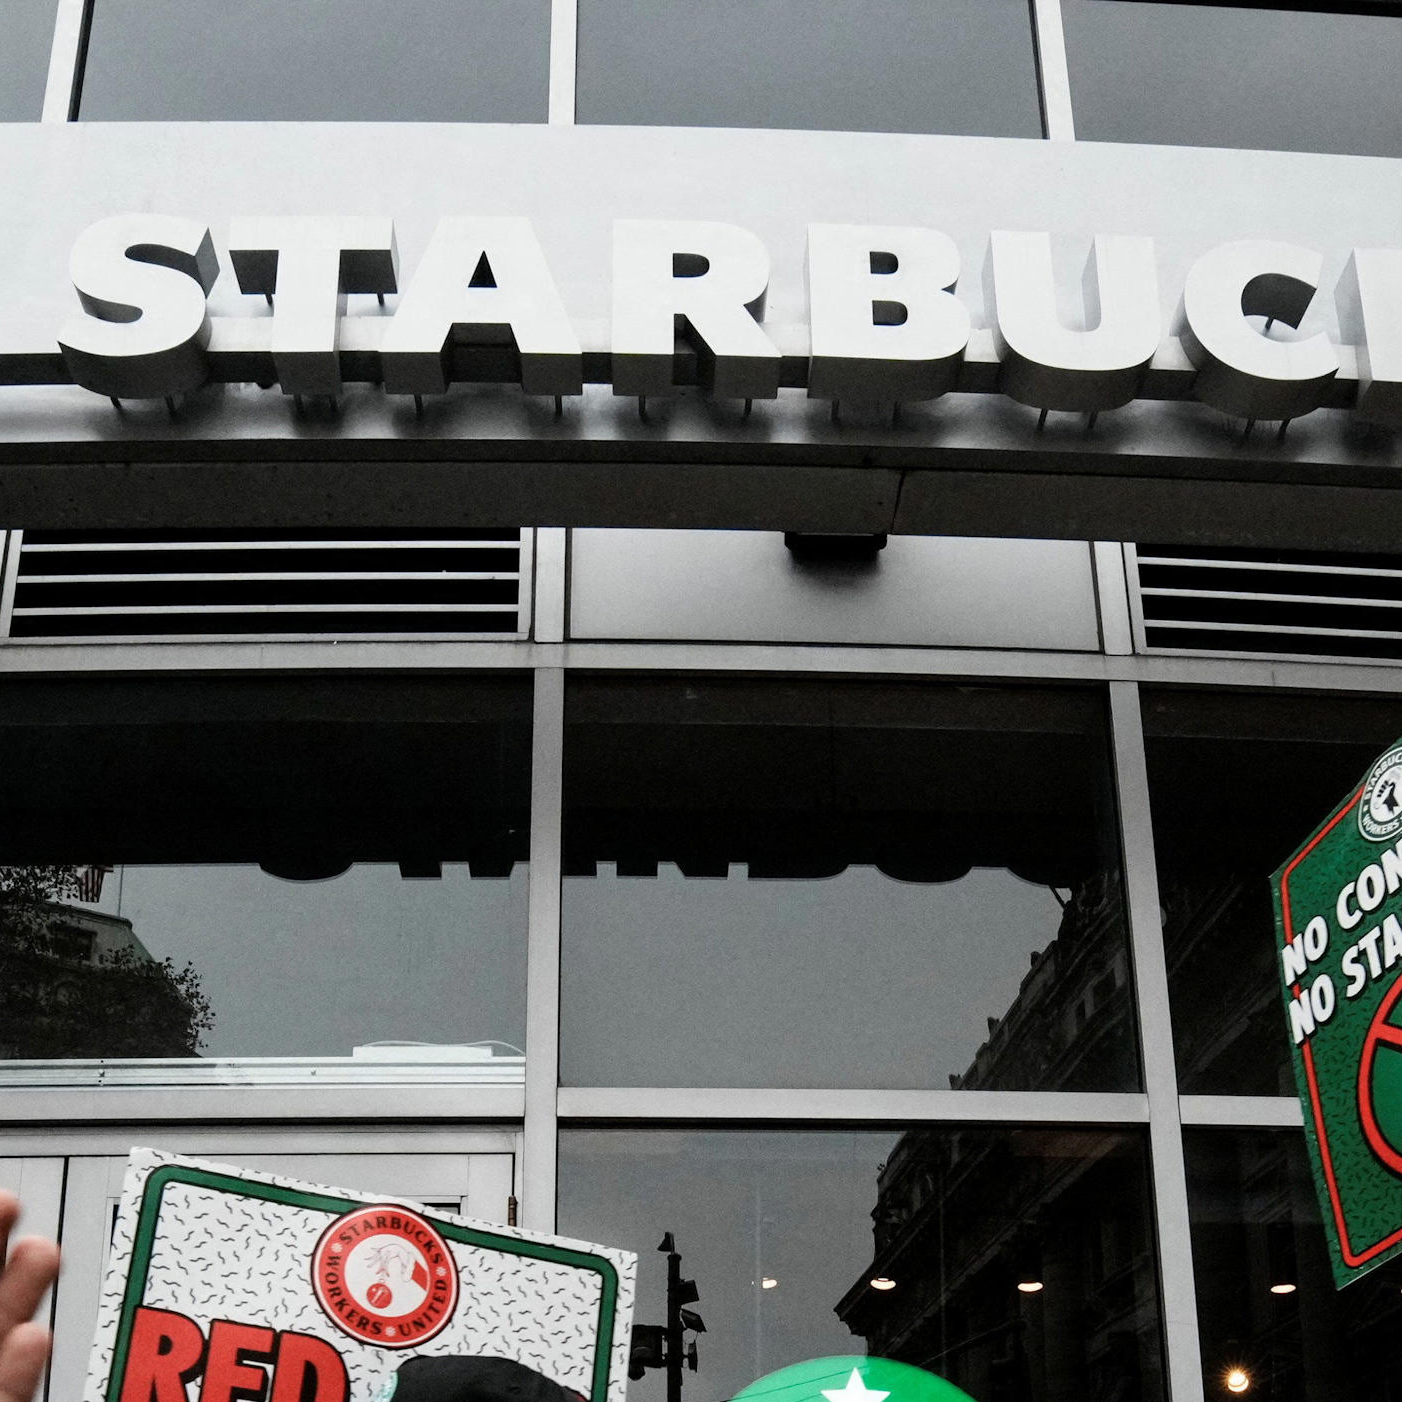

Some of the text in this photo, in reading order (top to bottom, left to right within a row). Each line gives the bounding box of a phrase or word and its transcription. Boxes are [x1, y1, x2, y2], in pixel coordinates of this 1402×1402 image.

[1361, 813, 1400, 835] WORKERS
[1281, 914, 1330, 987] NO
[1287, 973, 1336, 1046] NO
[339, 1215, 444, 1265] STARBUCKS
[325, 1255, 384, 1336] WORKERS
[398, 1279, 448, 1337] UNITED
